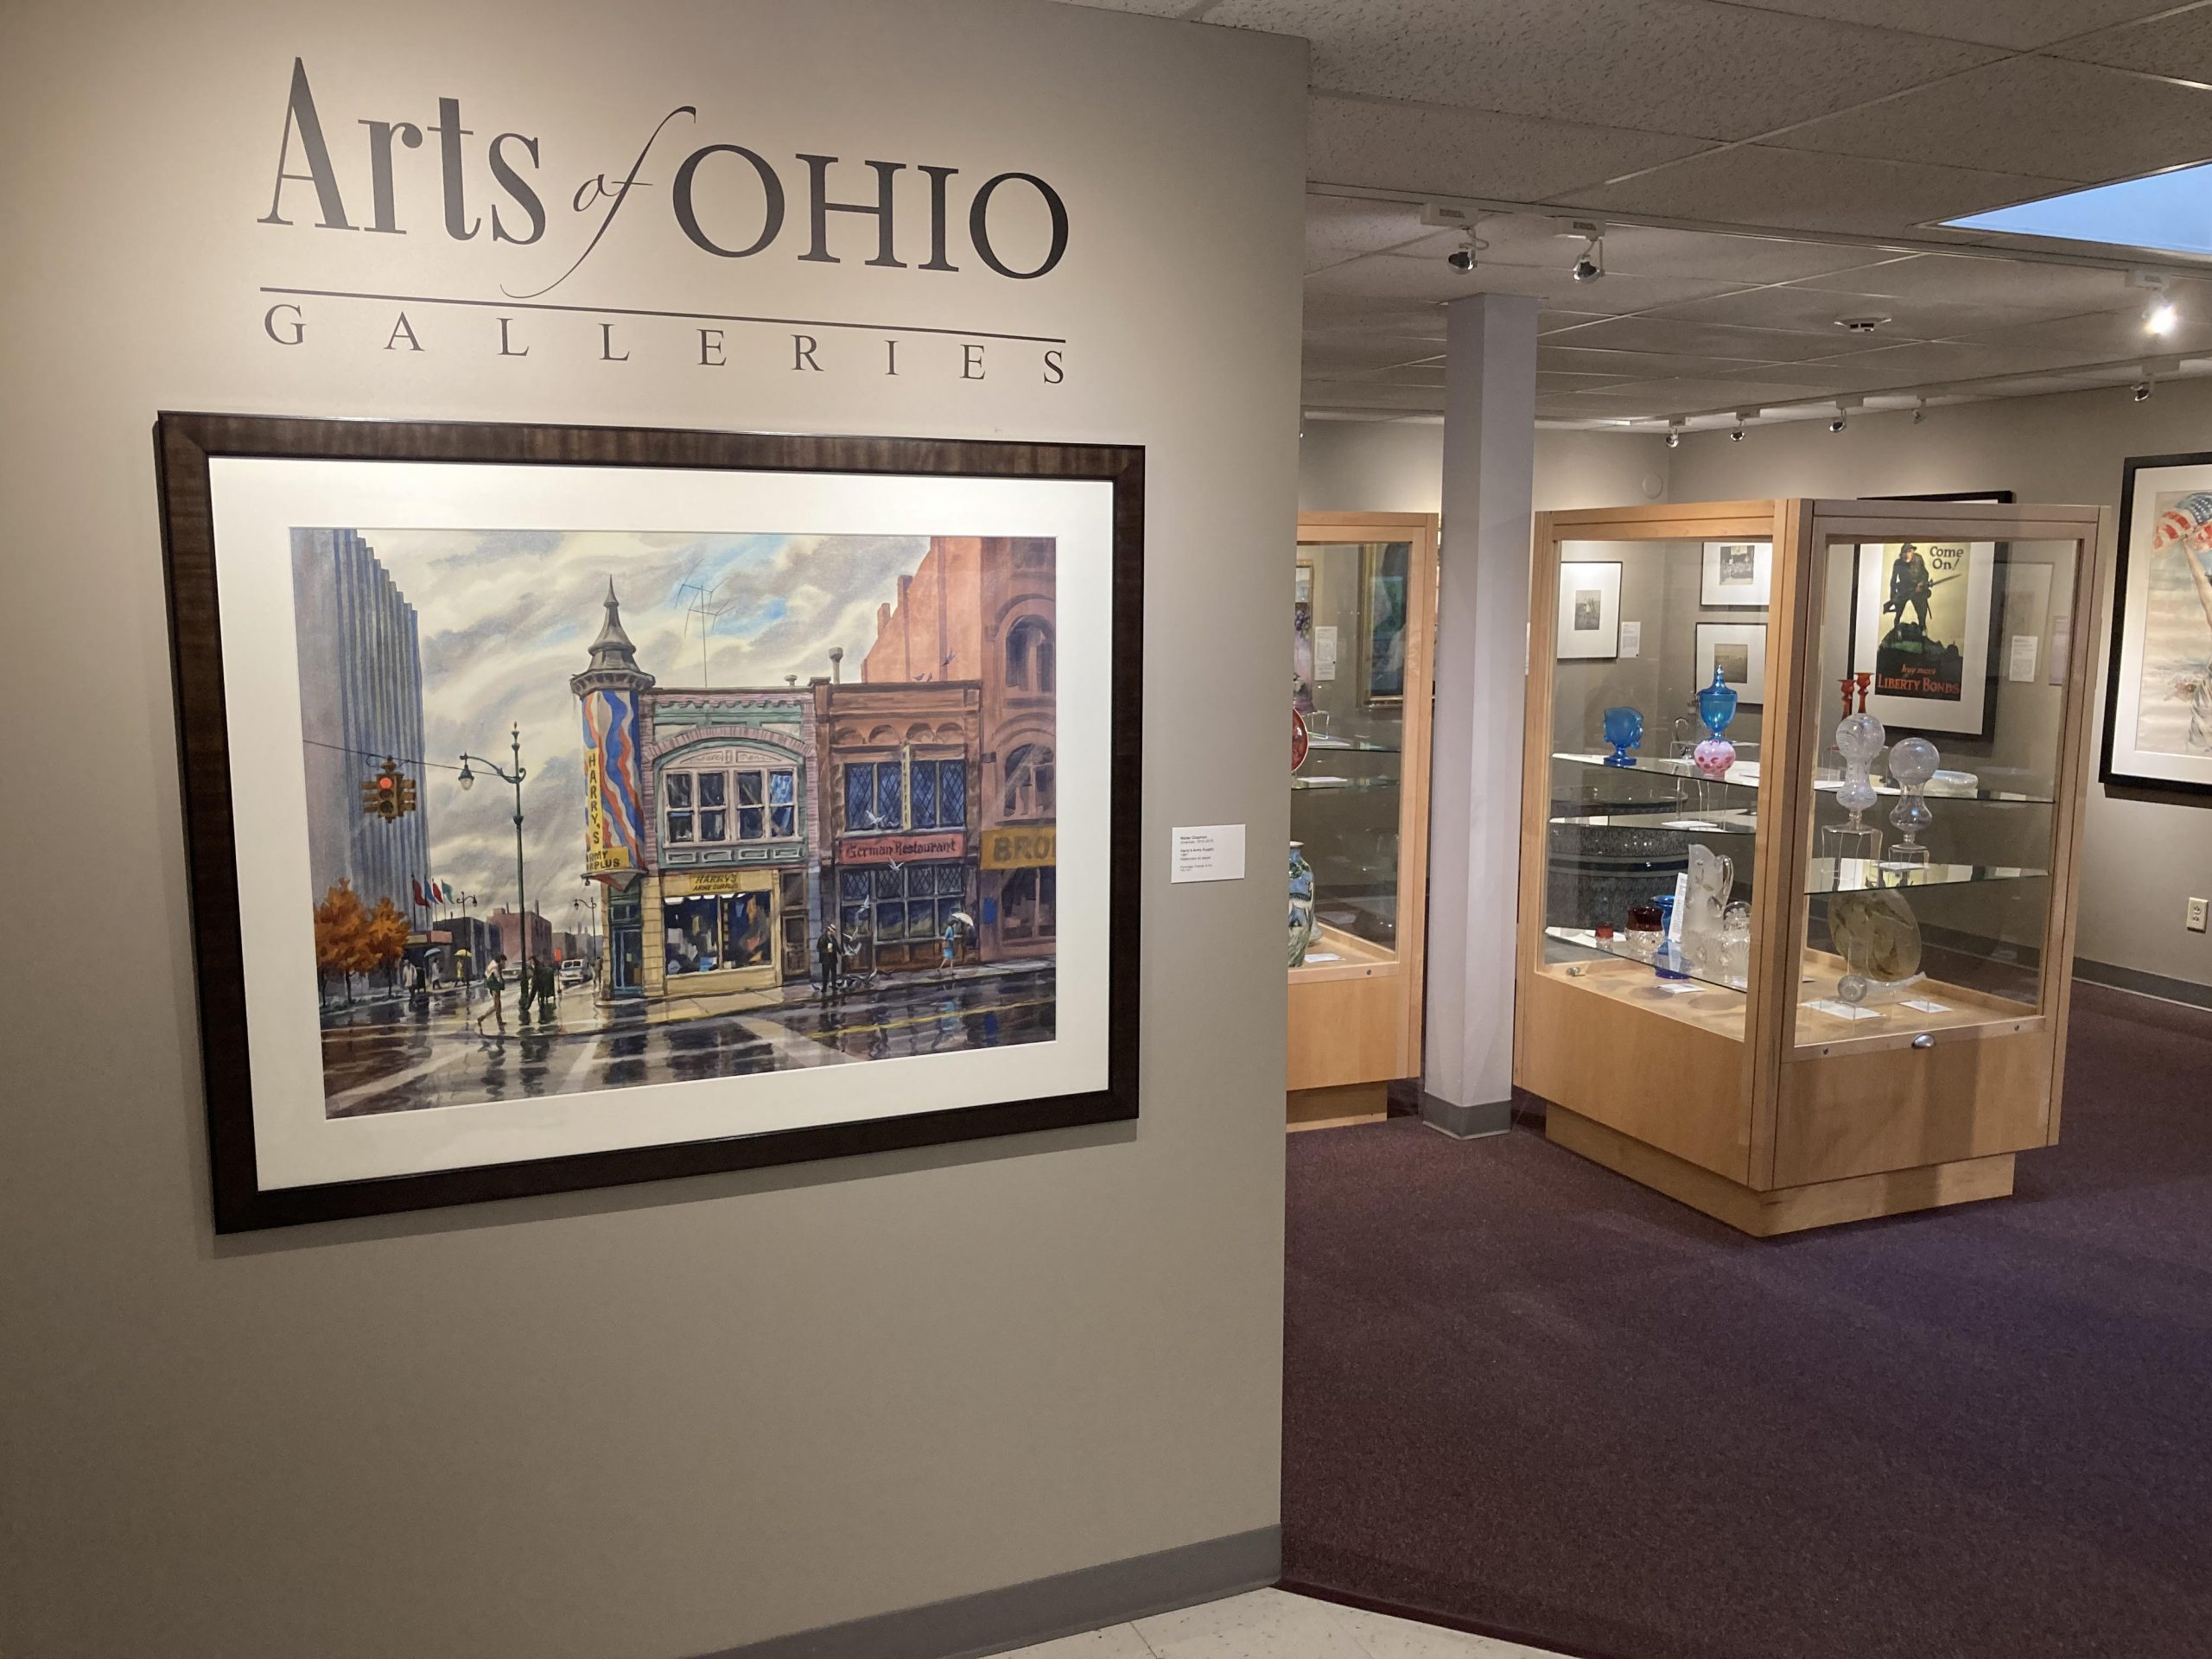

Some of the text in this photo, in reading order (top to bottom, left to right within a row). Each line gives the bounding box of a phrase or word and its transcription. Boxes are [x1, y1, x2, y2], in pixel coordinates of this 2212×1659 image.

[257, 56, 1070, 300] Arts of OHIO
[263, 302, 1066, 385] GALLERIES
[1929, 545, 1964, 558] Come
[1932, 557, 1960, 570] On!
[1878, 673, 1960, 696] LIBERTY BONDS
[588, 753, 601, 844] HARRY'S
[994, 835, 1056, 861] BRO
